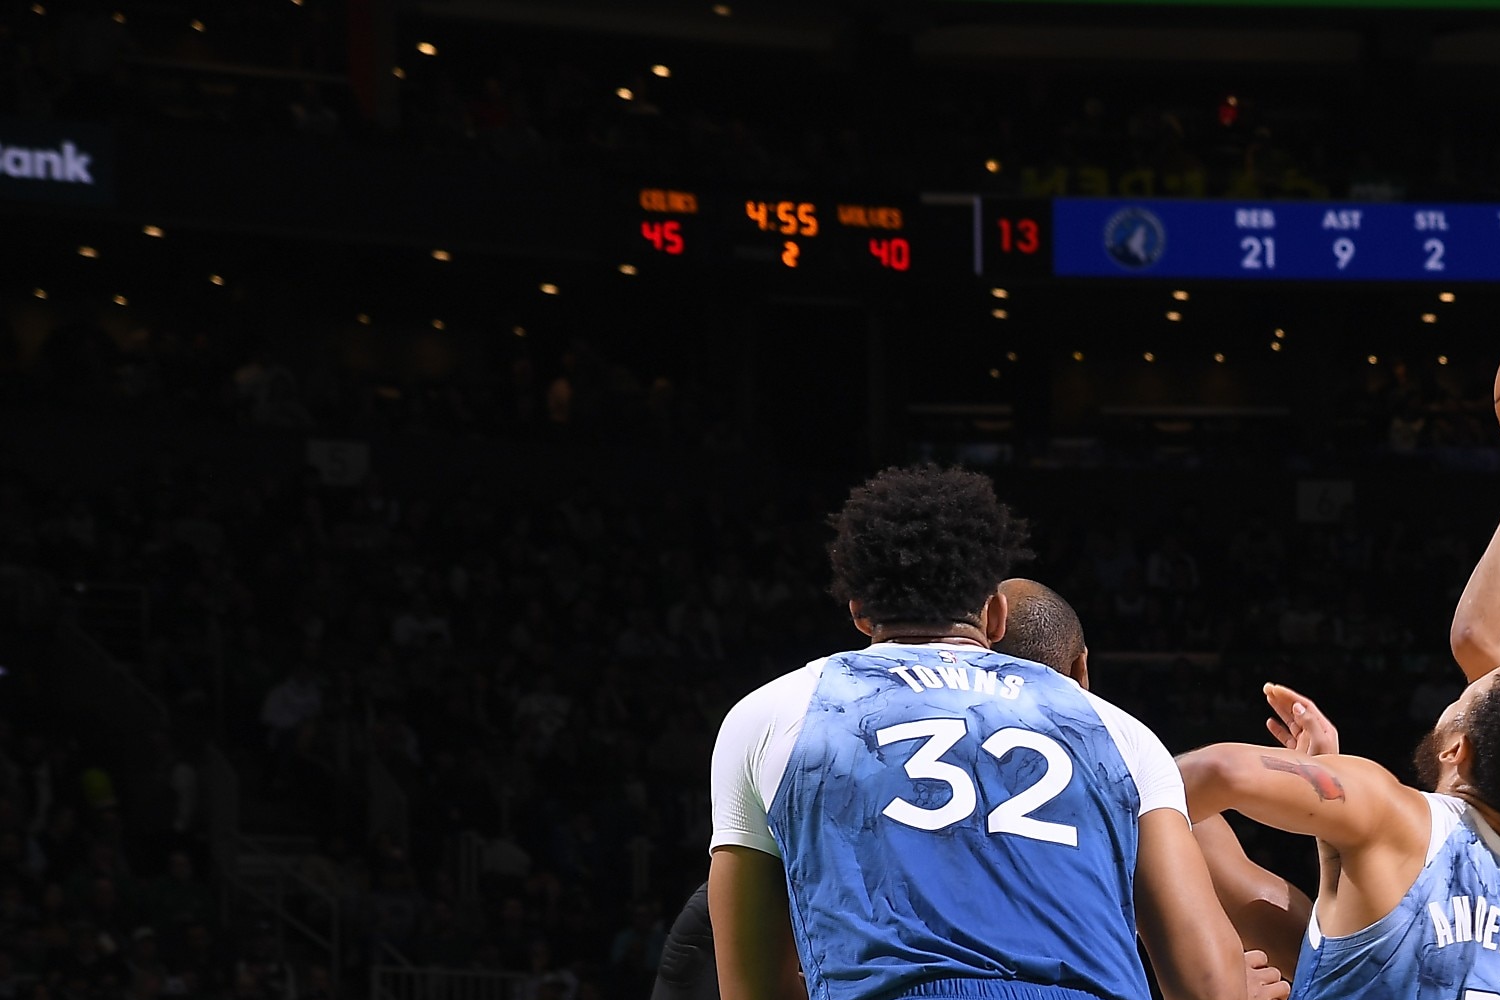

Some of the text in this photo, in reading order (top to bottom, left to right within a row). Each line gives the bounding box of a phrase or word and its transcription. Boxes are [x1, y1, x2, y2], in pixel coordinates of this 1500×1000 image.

[0, 140, 94, 185] ank
[745, 200, 819, 237] 4:55
[998, 218, 1039, 254] 13
[1236, 209, 1275, 229] REB
[1322, 210, 1362, 229] AST
[1414, 210, 1449, 231] STL
[641, 220, 684, 255] 45
[781, 241, 801, 268] 2
[868, 238, 911, 271] 40
[1241, 237, 1275, 269] 21
[1333, 238, 1355, 270] 9
[1424, 239, 1445, 271] 2
[888, 664, 1025, 700] TOWNS
[876, 718, 1079, 848] 32
